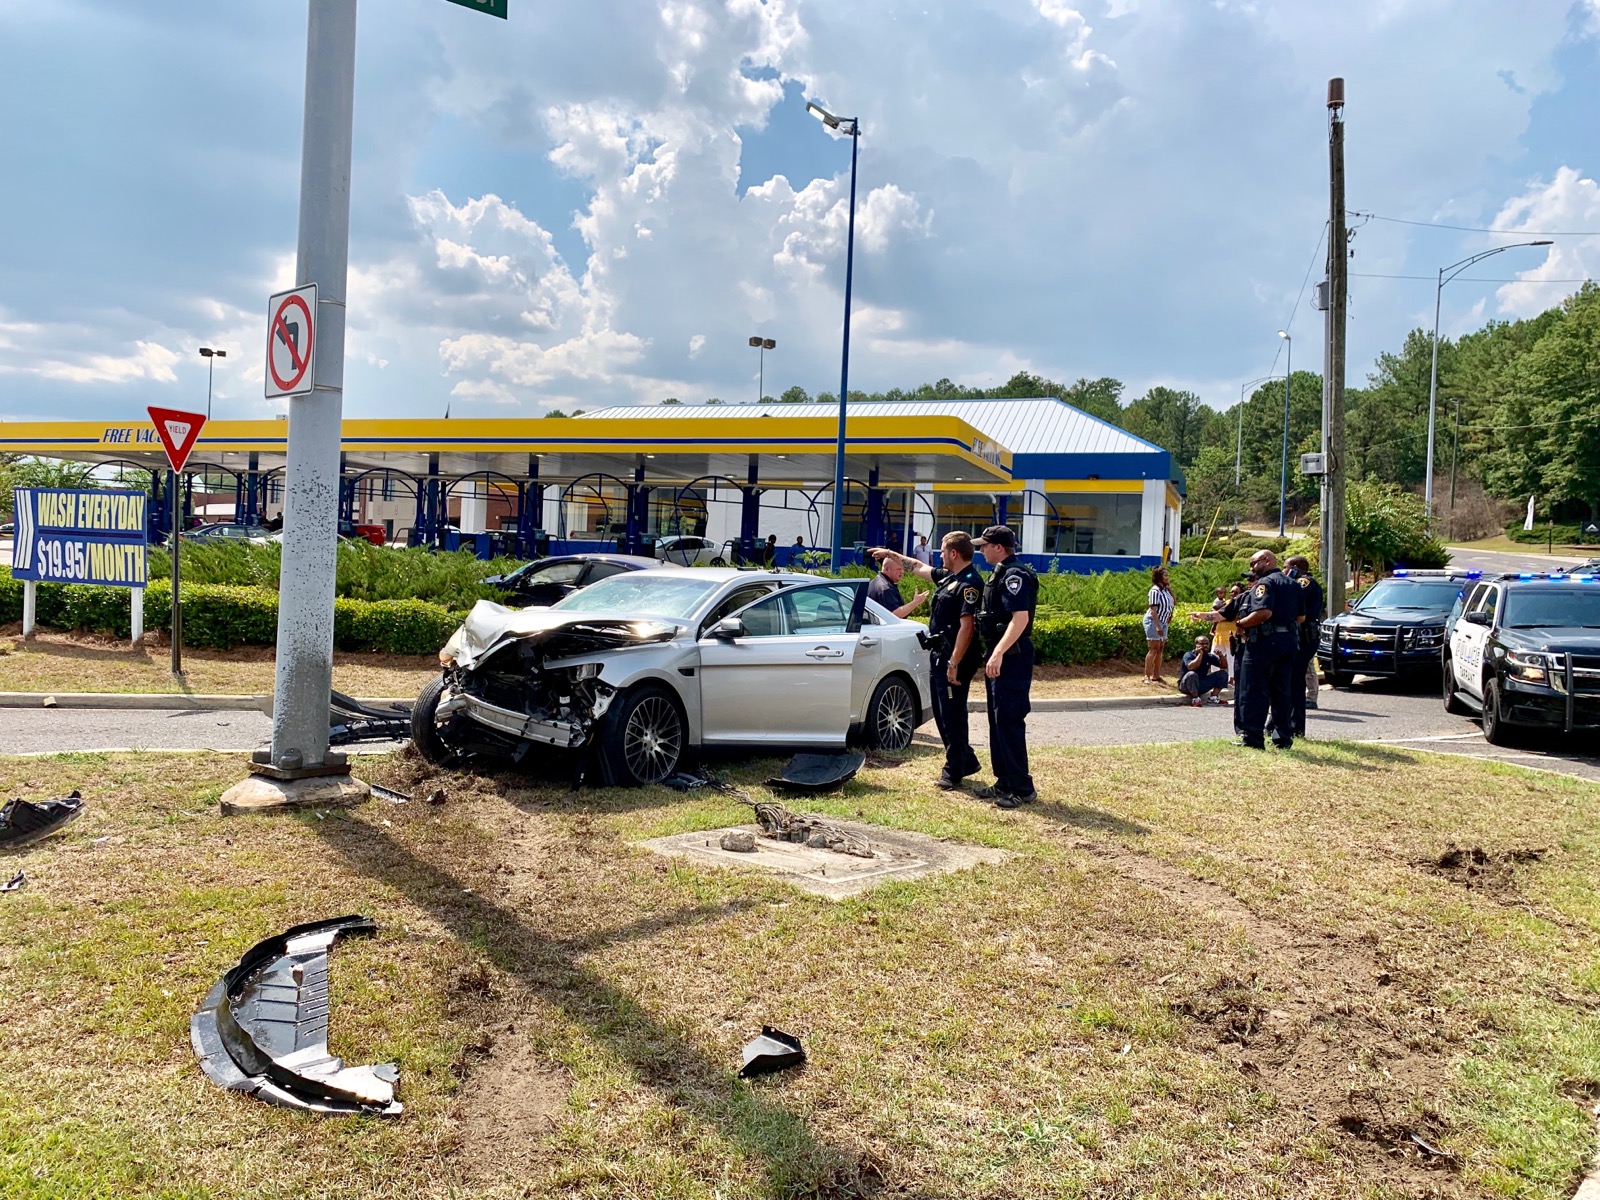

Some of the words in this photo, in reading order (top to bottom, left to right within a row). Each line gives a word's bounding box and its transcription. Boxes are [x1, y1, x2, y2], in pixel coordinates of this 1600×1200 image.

[103, 428, 133, 443] FREE
[168, 424, 187, 435] YIELD
[37, 492, 76, 528] WASH
[78, 493, 145, 531] EVERYDAY
[37, 537, 145, 582] $19.95/MONTH
[1455, 638, 1481, 668] POLICE
